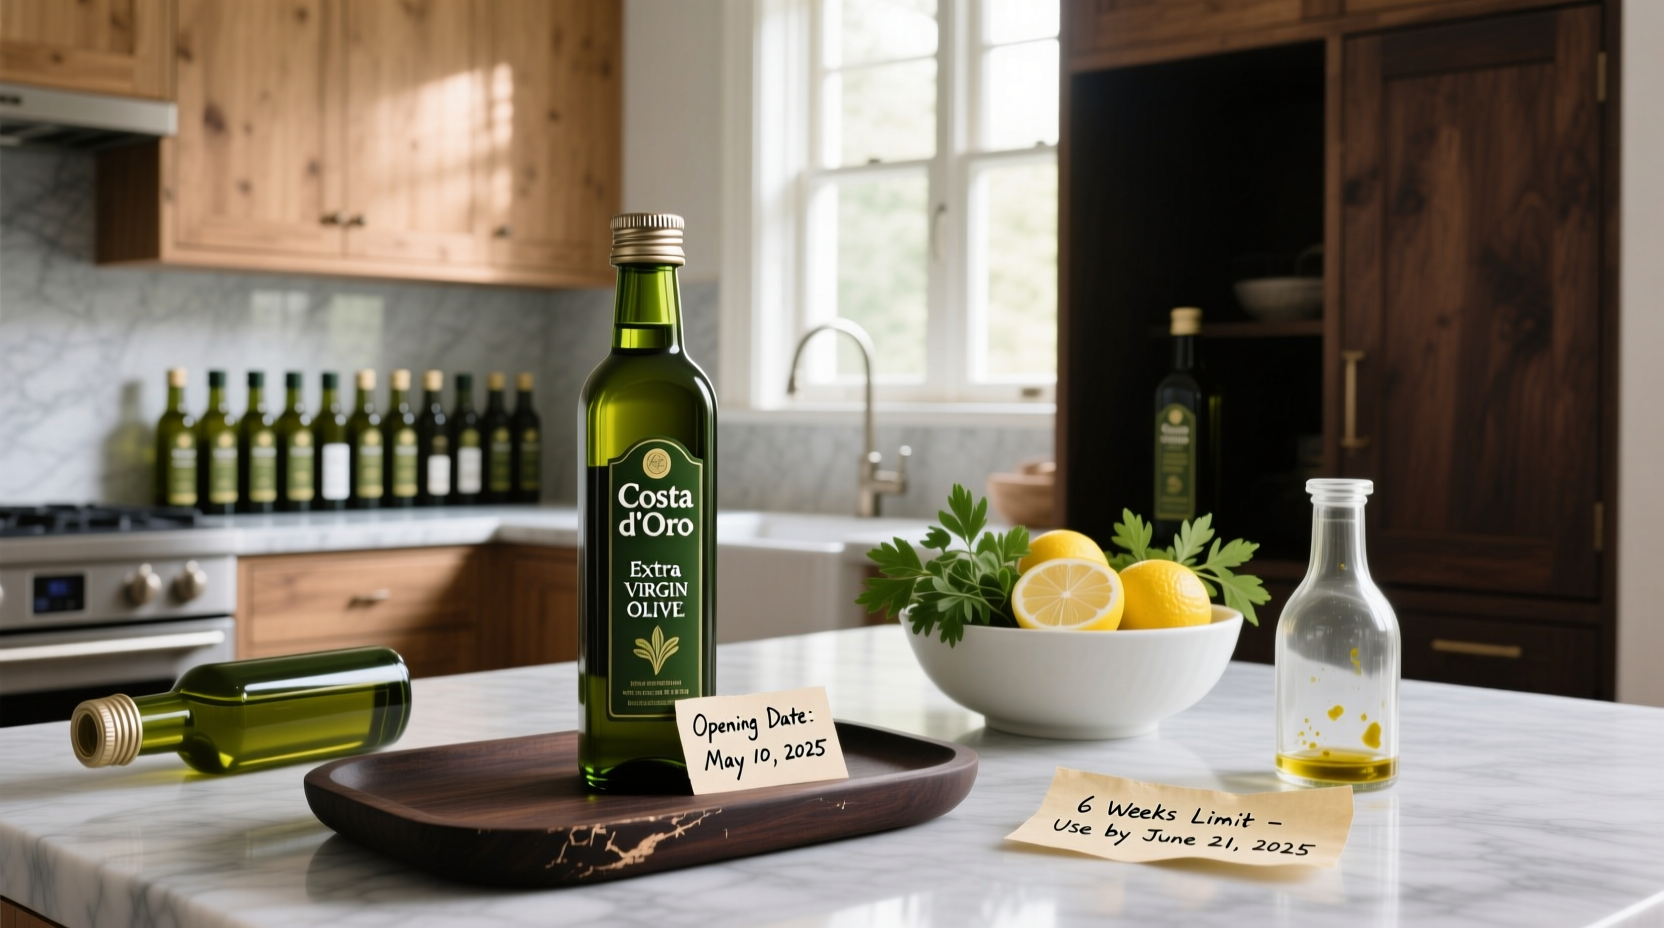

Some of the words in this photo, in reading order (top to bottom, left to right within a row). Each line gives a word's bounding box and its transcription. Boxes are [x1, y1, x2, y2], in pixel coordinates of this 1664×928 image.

[618, 482, 695, 509] Costa
[618, 511, 694, 537] d'Oro
[630, 560, 682, 578] Extra
[623, 581, 689, 598] VIRGIN
[626, 600, 686, 618] OLIVE
[692, 713, 759, 744] Opening
[766, 706, 814, 729] Date:
[704, 749, 745, 781] May
[754, 748, 778, 768] 10,
[783, 738, 827, 761] 2025
[1077, 795, 1095, 814] 6
[1107, 800, 1177, 822] Weeks
[1190, 807, 1256, 829] Limit
[1053, 818, 1092, 835] Use
[1104, 823, 1131, 847] by
[1142, 828, 1196, 846] June
[1207, 835, 1239, 852] 21,
[1251, 839, 1316, 856] 2025
